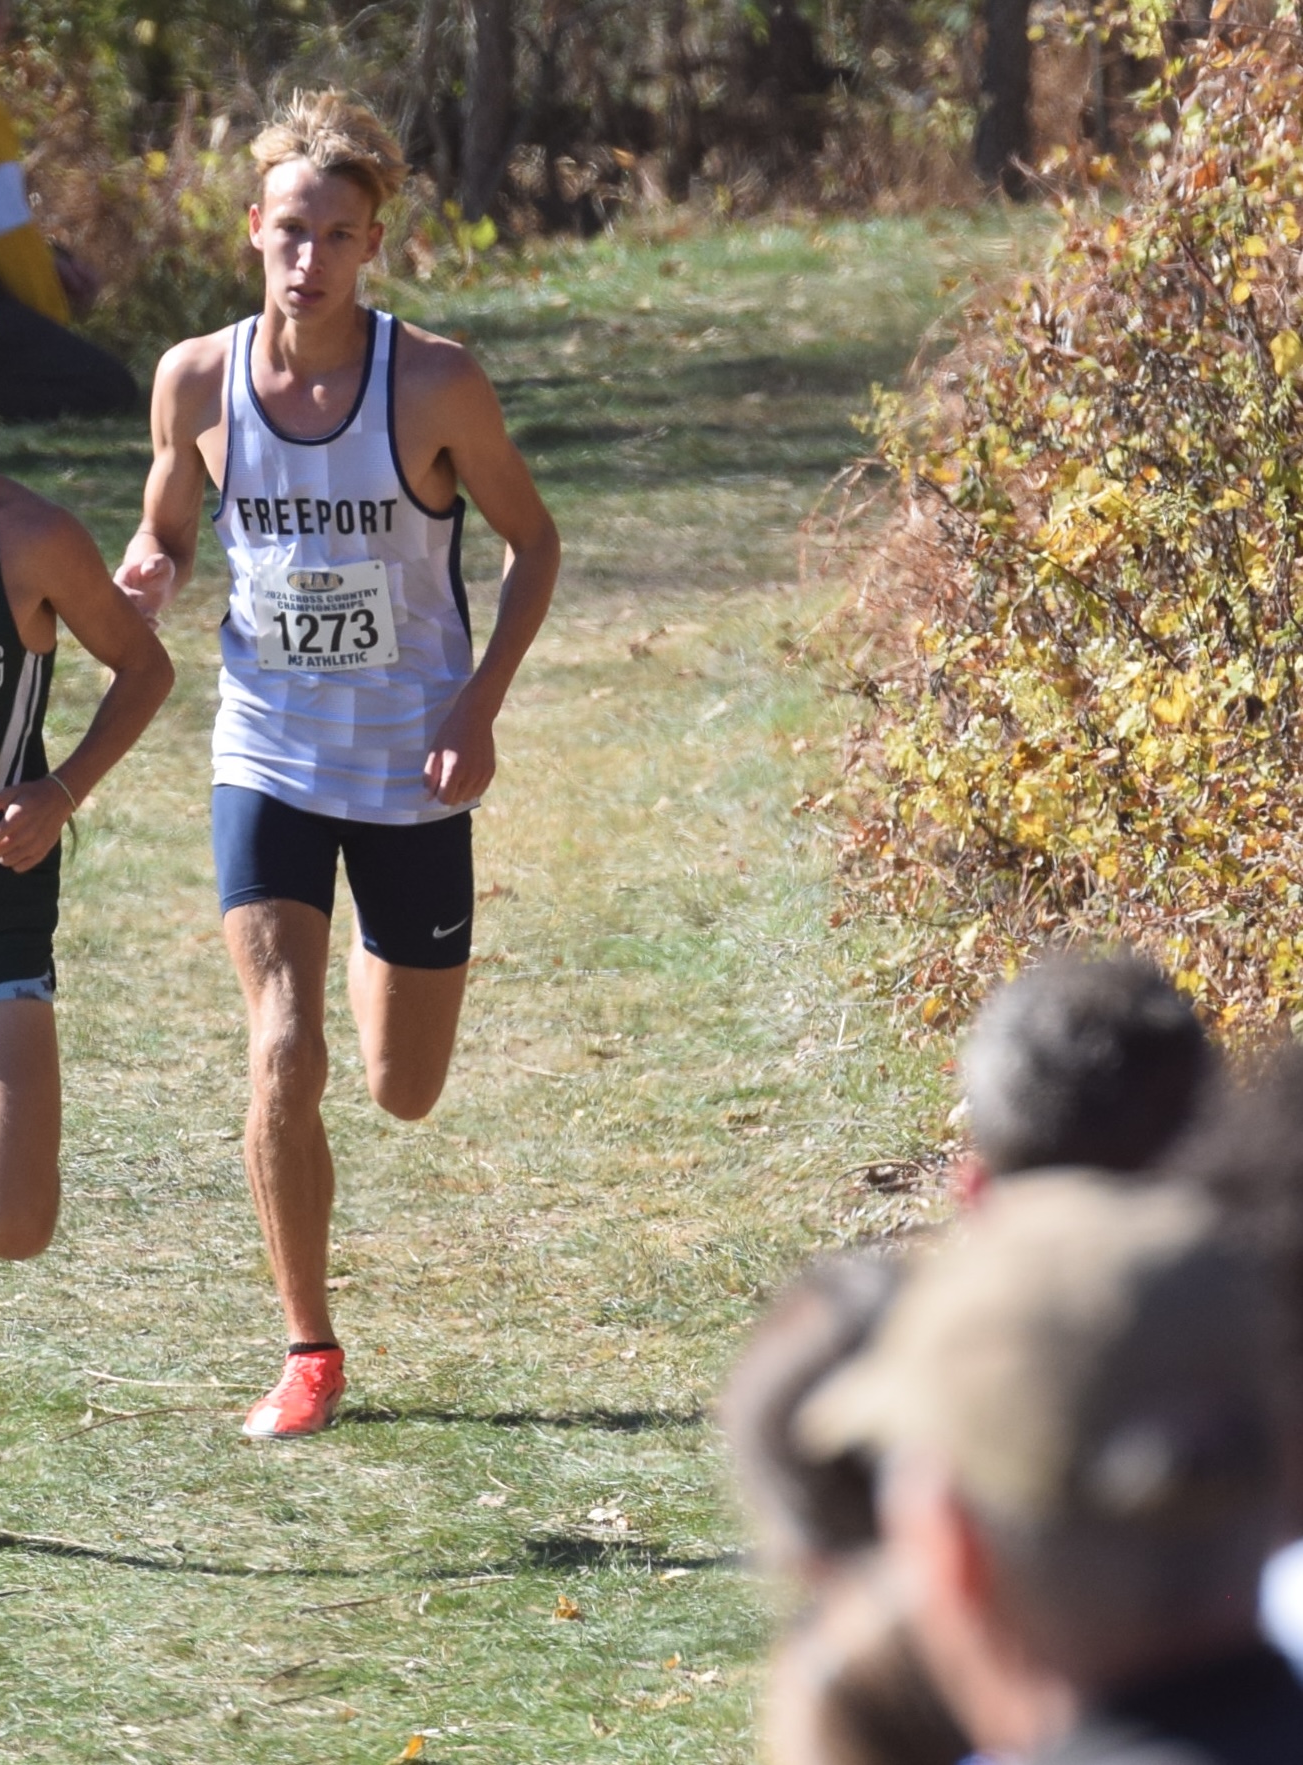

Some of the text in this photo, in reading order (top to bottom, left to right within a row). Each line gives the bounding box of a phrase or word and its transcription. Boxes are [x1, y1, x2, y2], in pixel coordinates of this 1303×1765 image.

[236, 497, 398, 535] FREEPORT
[265, 588, 379, 603] 2024 CROSS COUNTRY
[277, 600, 365, 612] CHAMPIONSHIPS
[273, 608, 379, 653] 1273
[306, 651, 368, 667] ATHLETIC
